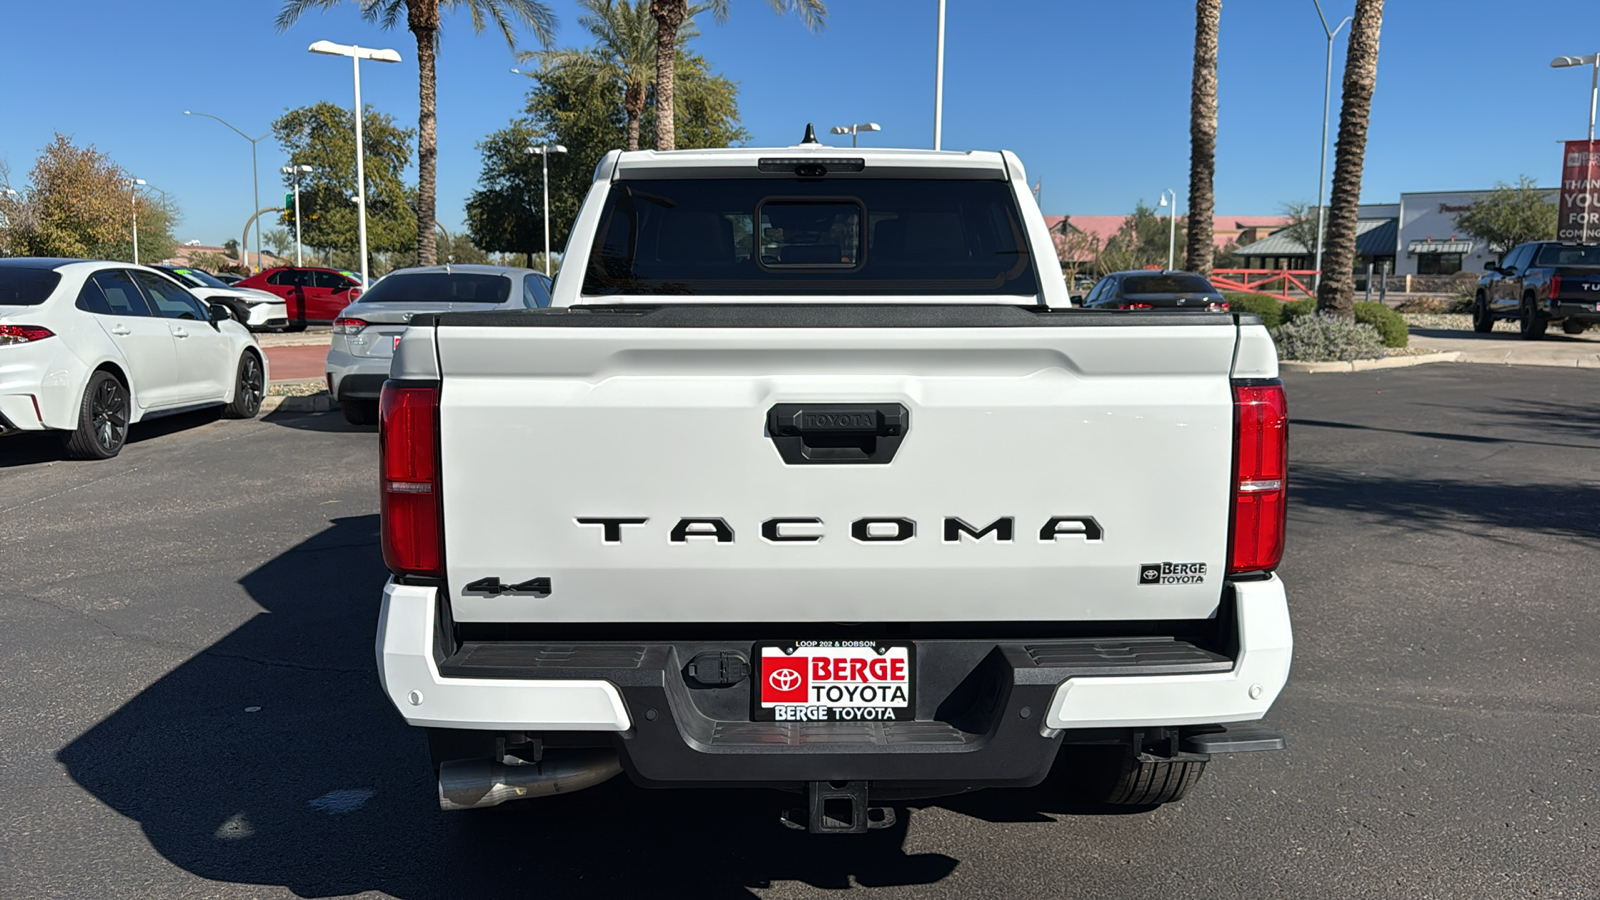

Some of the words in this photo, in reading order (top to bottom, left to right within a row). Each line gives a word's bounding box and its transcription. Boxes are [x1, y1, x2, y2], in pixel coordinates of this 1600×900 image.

[1569, 212, 1599, 224] FOR
[1559, 229, 1600, 238] COMNG
[805, 414, 873, 427] TOYOTA
[573, 516, 1104, 544] TACOMA
[1161, 562, 1207, 575] BERGE
[1161, 575, 1205, 584] TOYOTA
[811, 656, 906, 683] BERGE
[811, 685, 907, 703] TOYOTA
[774, 705, 828, 722] BERGE
[832, 707, 896, 720] TOYOTA
